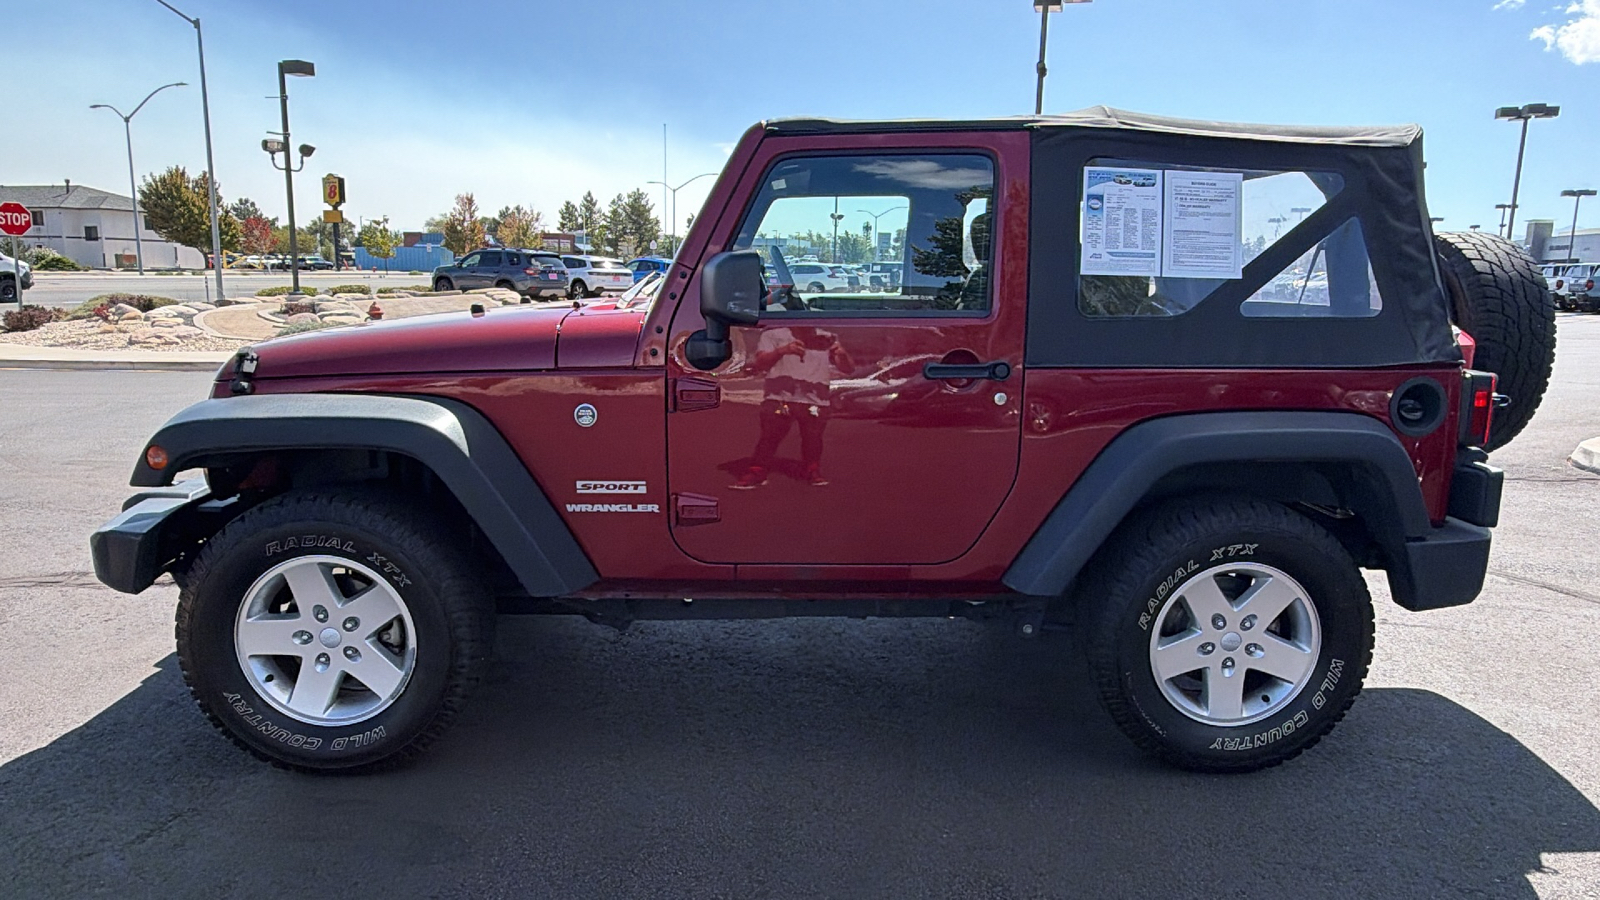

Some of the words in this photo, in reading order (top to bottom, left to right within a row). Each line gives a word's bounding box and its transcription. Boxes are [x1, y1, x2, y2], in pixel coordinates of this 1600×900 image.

[327, 184, 338, 199] 8
[0, 211, 30, 226] STOP
[578, 483, 643, 492] SPORT
[565, 503, 660, 513] WRANGLER
[265, 534, 357, 556] RADIAL
[366, 551, 412, 587] XTX
[1138, 559, 1200, 631] RADIAL
[1209, 543, 1259, 561] XTX
[1311, 658, 1345, 710] WILD
[223, 690, 322, 750] COUNTRY
[1208, 709, 1309, 751] COUNTRY
[330, 725, 387, 750] WILD
